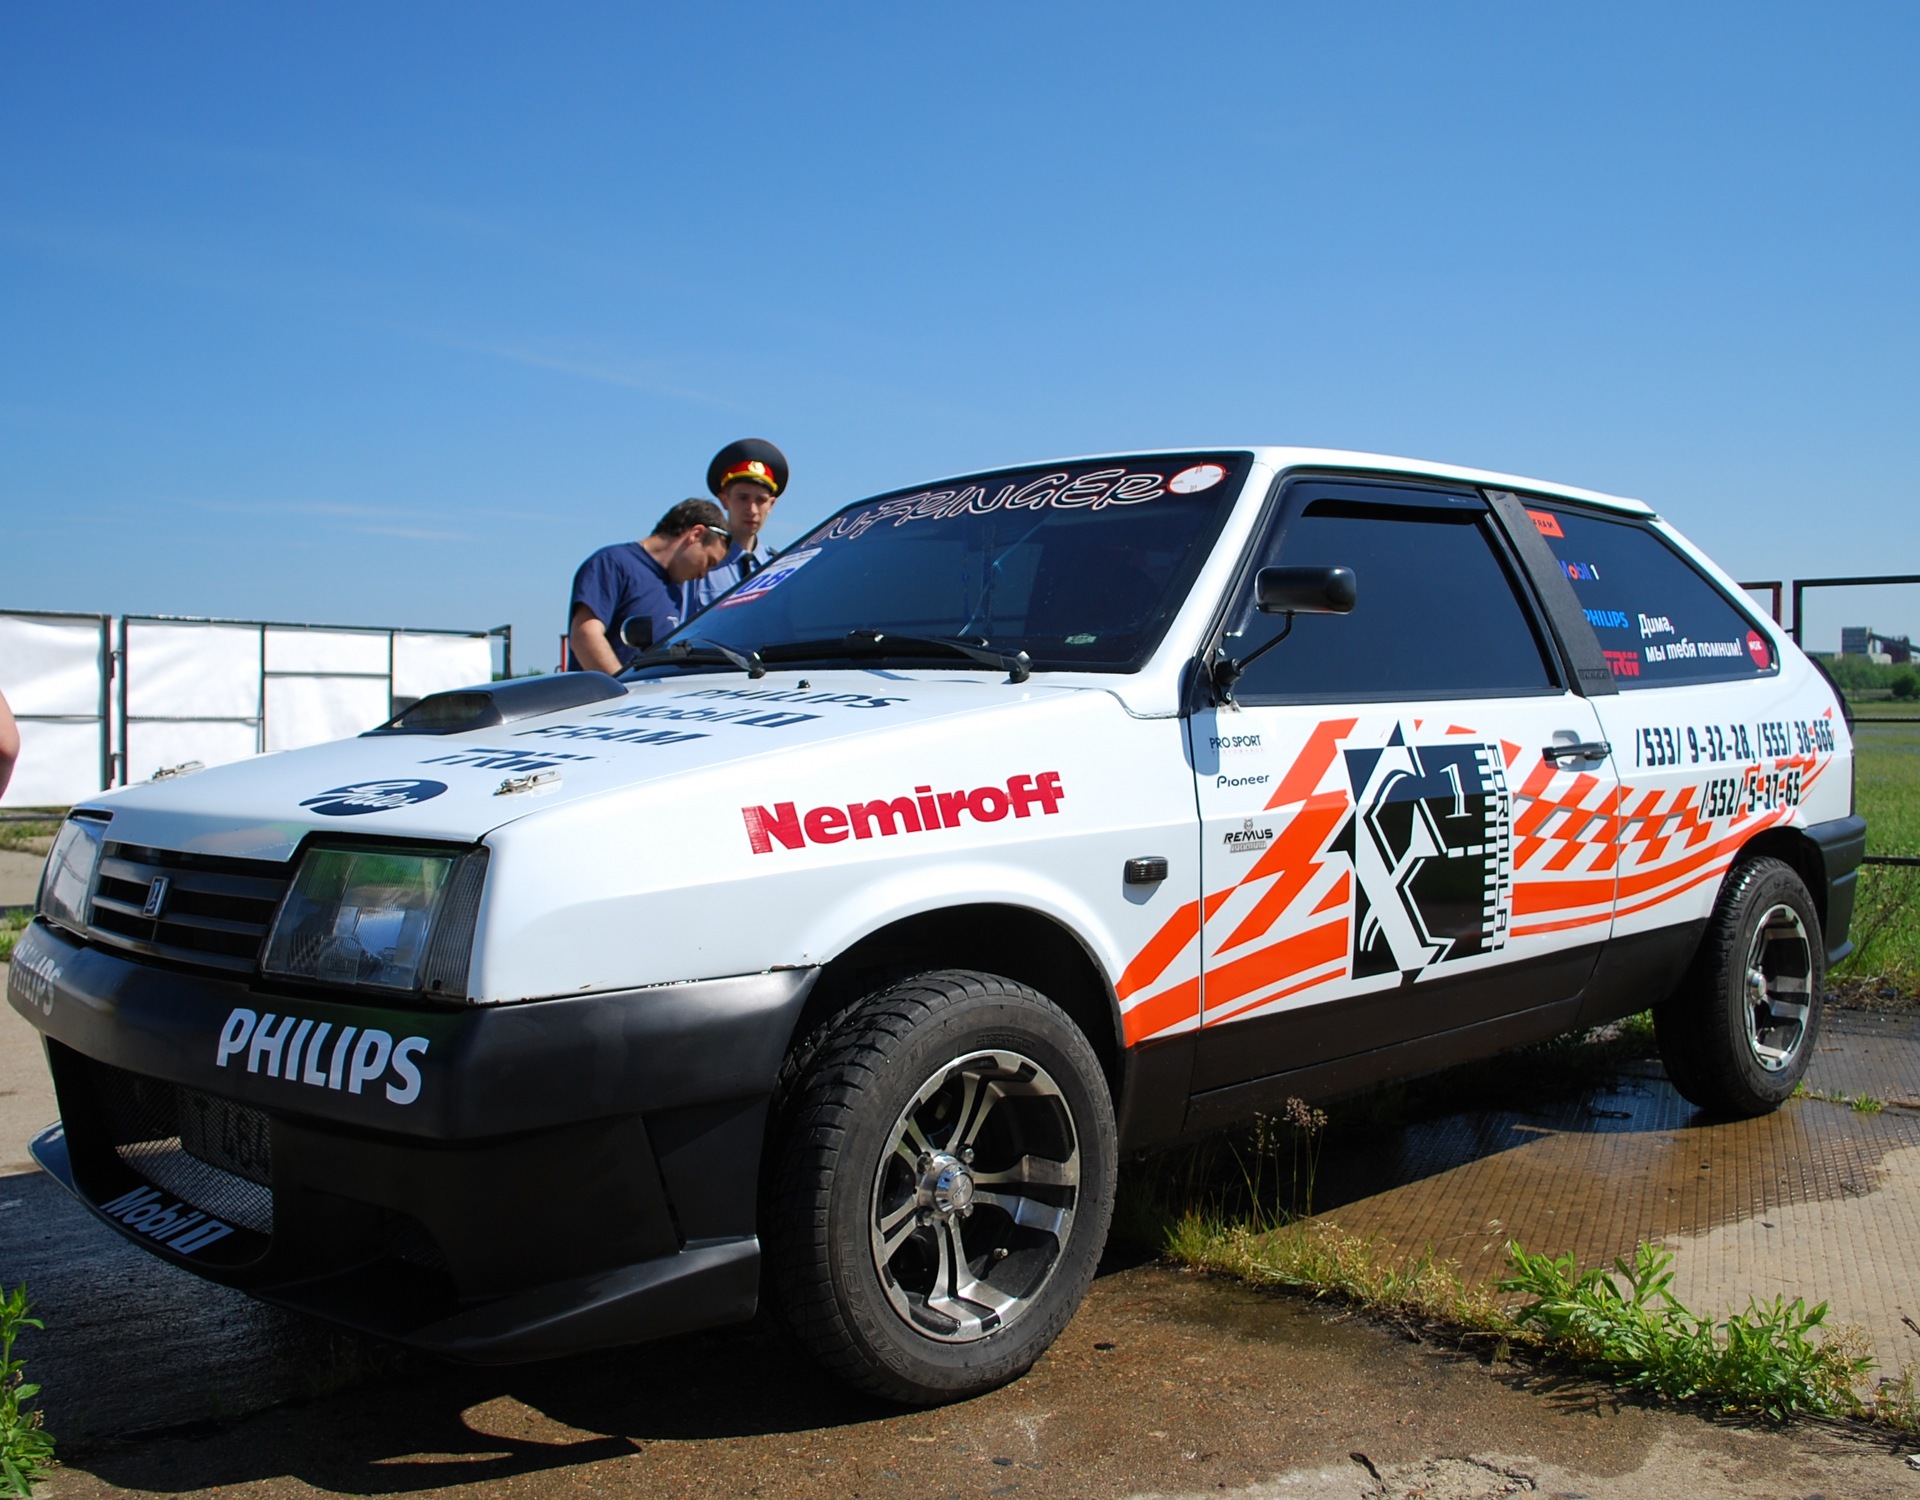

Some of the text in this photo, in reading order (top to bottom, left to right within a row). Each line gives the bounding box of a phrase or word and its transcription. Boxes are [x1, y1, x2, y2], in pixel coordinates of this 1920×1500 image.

[1589, 564, 1600, 580] 1
[671, 689, 911, 708] PHILIPS
[588, 705, 764, 722] Mobil
[510, 725, 713, 745] FRAM
[1209, 735, 1261, 749] PRO SPORT
[417, 748, 598, 772] TRW
[1216, 775, 1270, 789] Pioneer
[1747, 771, 1800, 812] 5-37-65
[741, 771, 1065, 855] Nemiroff
[1223, 828, 1274, 844] REMUS
[216, 1007, 430, 1105] PHILIPS
[100, 1185, 206, 1240] Mobil
